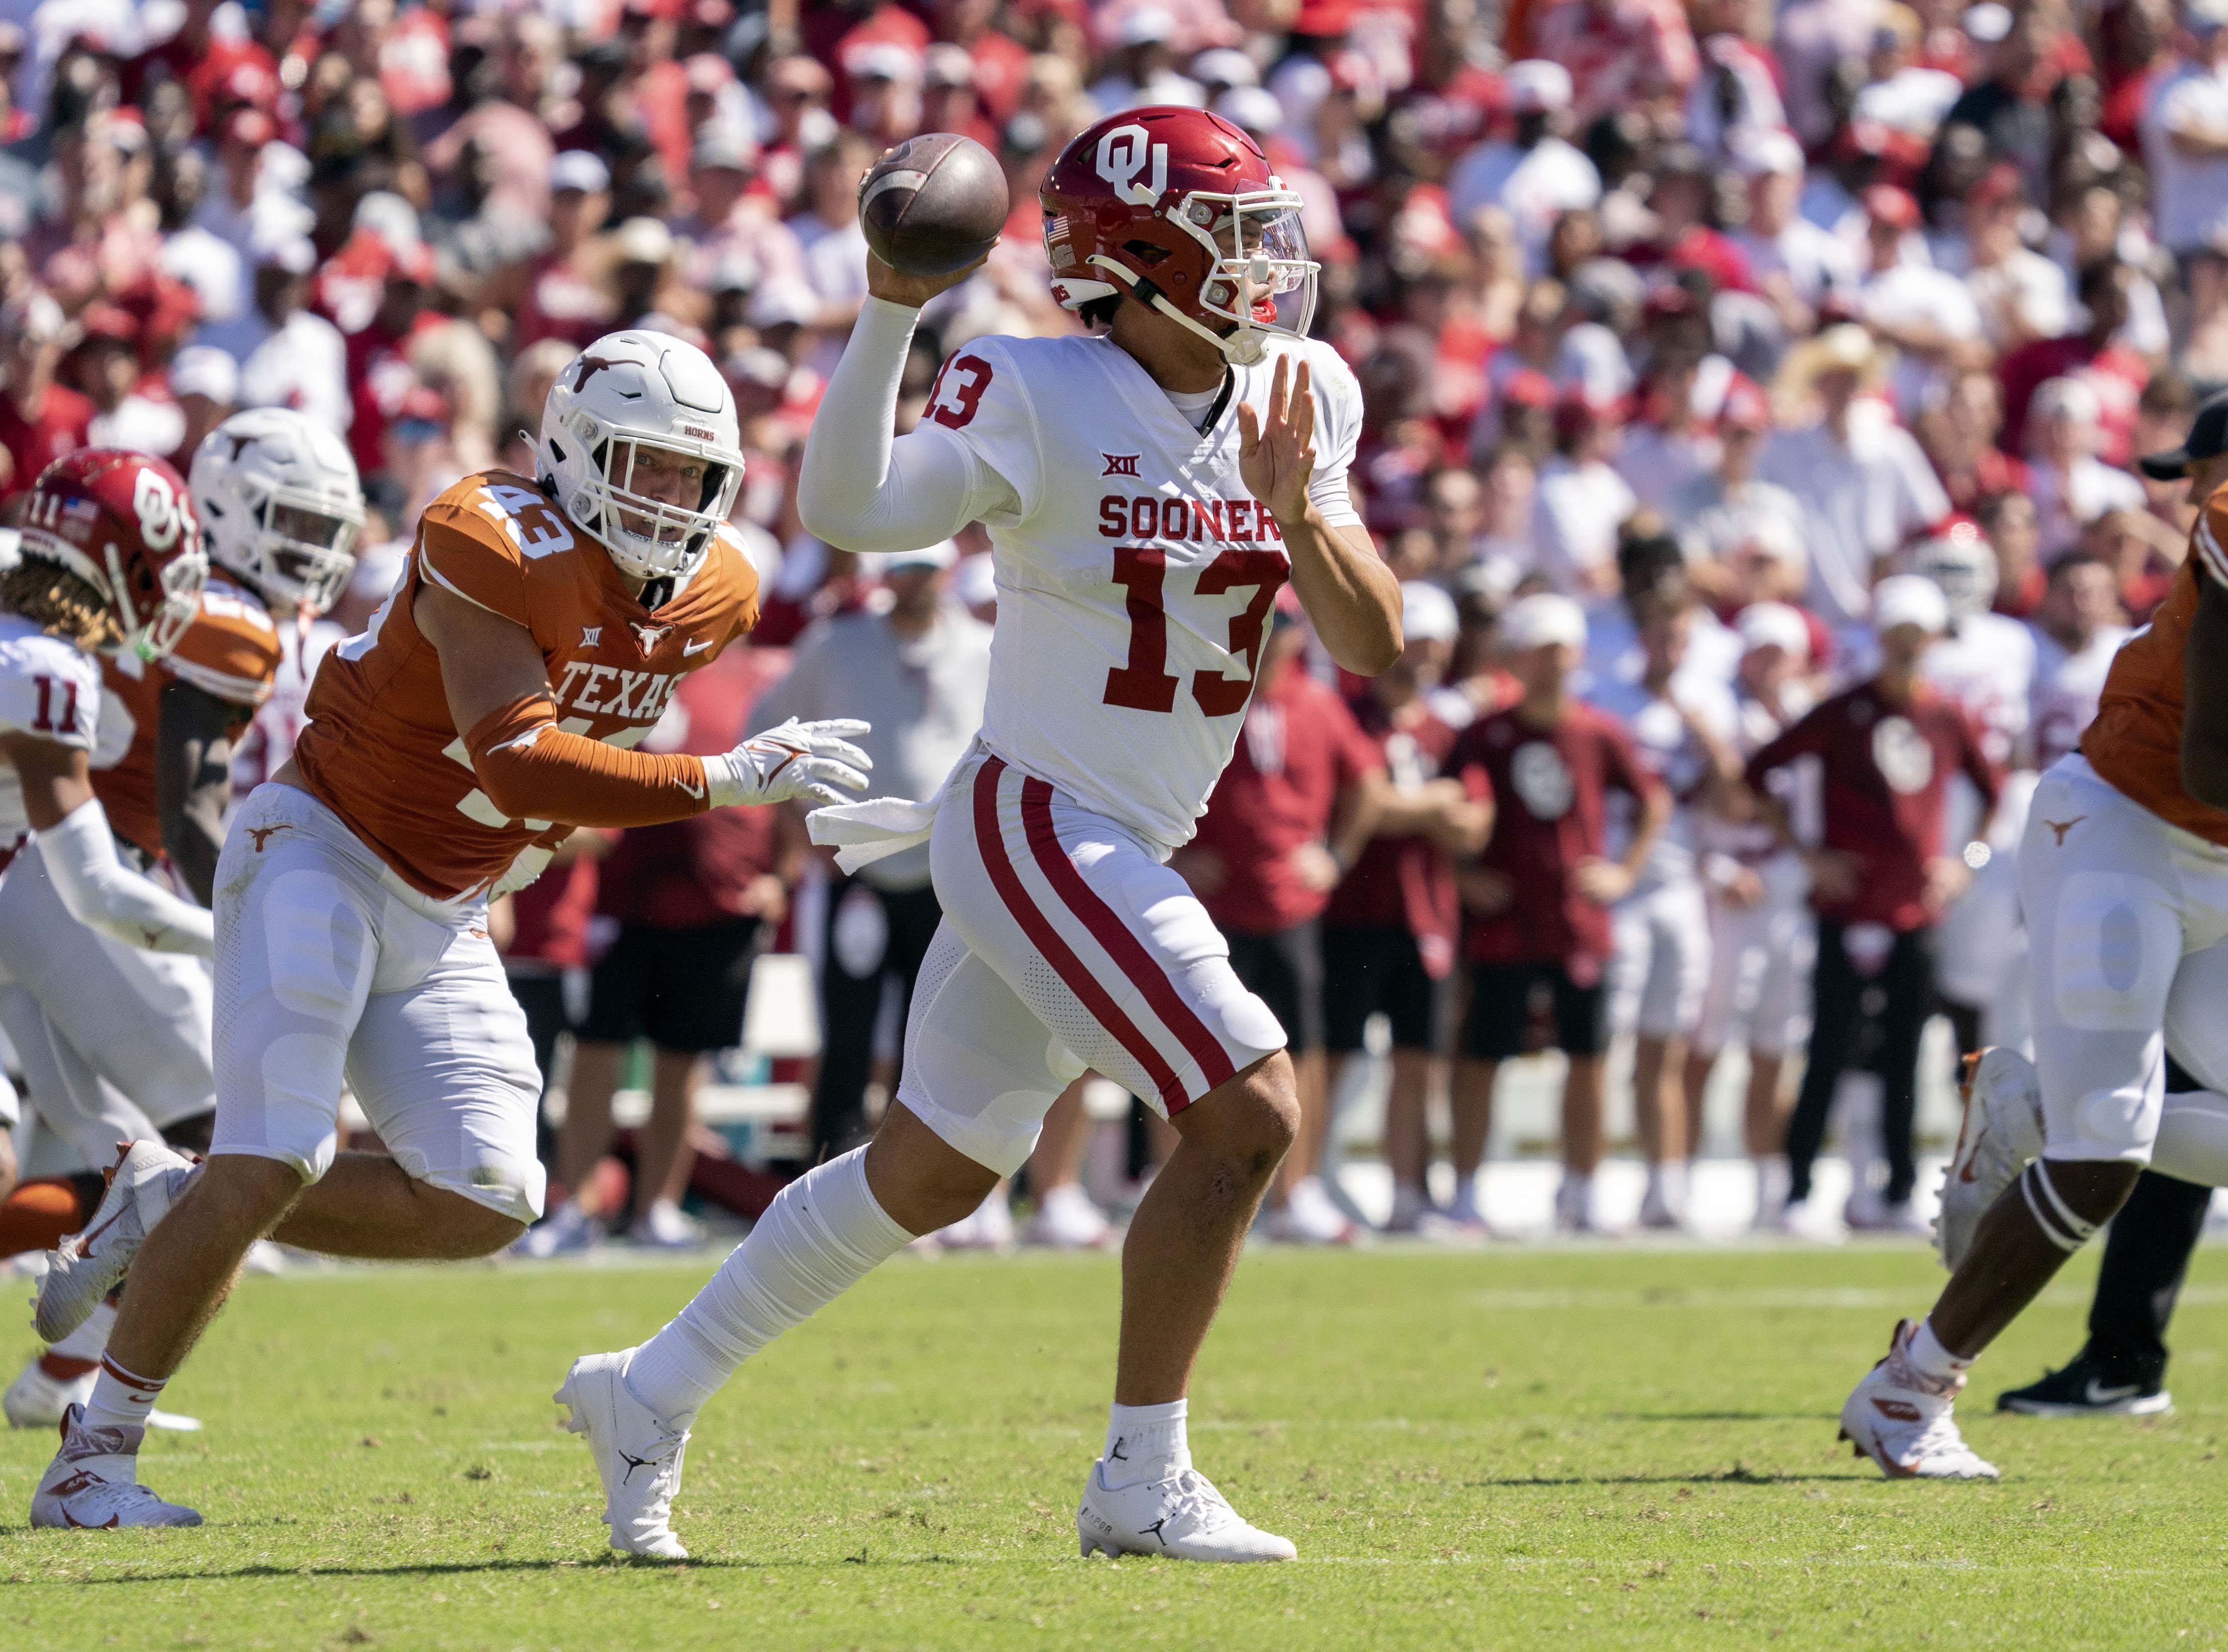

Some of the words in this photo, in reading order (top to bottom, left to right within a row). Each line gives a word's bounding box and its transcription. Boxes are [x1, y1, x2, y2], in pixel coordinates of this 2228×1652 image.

[684, 425, 714, 441] HORNS
[1101, 452, 1141, 477] XII
[30, 491, 60, 528] 11
[477, 484, 575, 559] 43
[579, 626, 603, 647] XII
[1103, 547, 1291, 717] 13
[32, 673, 78, 733] 11
